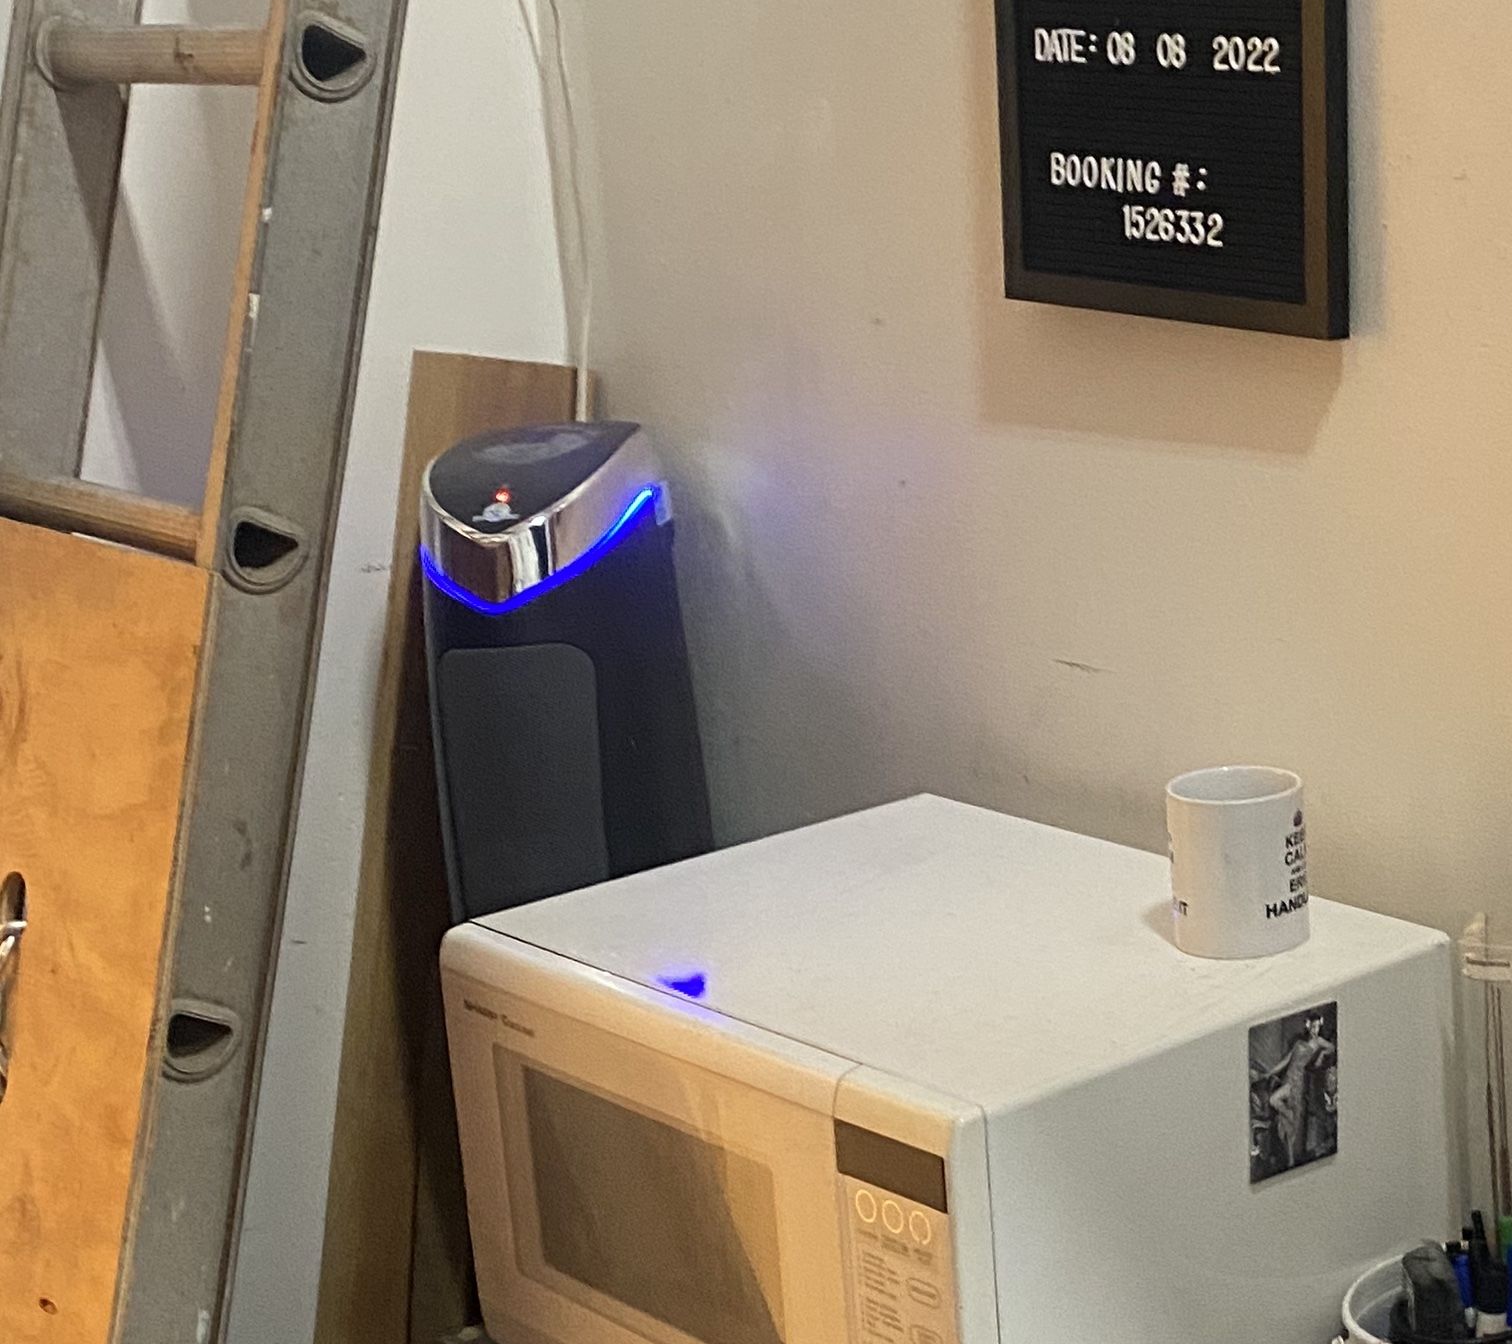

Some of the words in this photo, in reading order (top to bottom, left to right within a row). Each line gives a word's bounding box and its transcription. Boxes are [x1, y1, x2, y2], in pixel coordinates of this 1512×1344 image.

[1034, 27, 1098, 64] DATE:
[1106, 31, 1136, 66] 08
[1156, 32, 1187, 69] 08
[1212, 35, 1281, 73] 2022
[1049, 152, 1161, 194] BOOKING
[1122, 204, 1223, 247] 1526332
